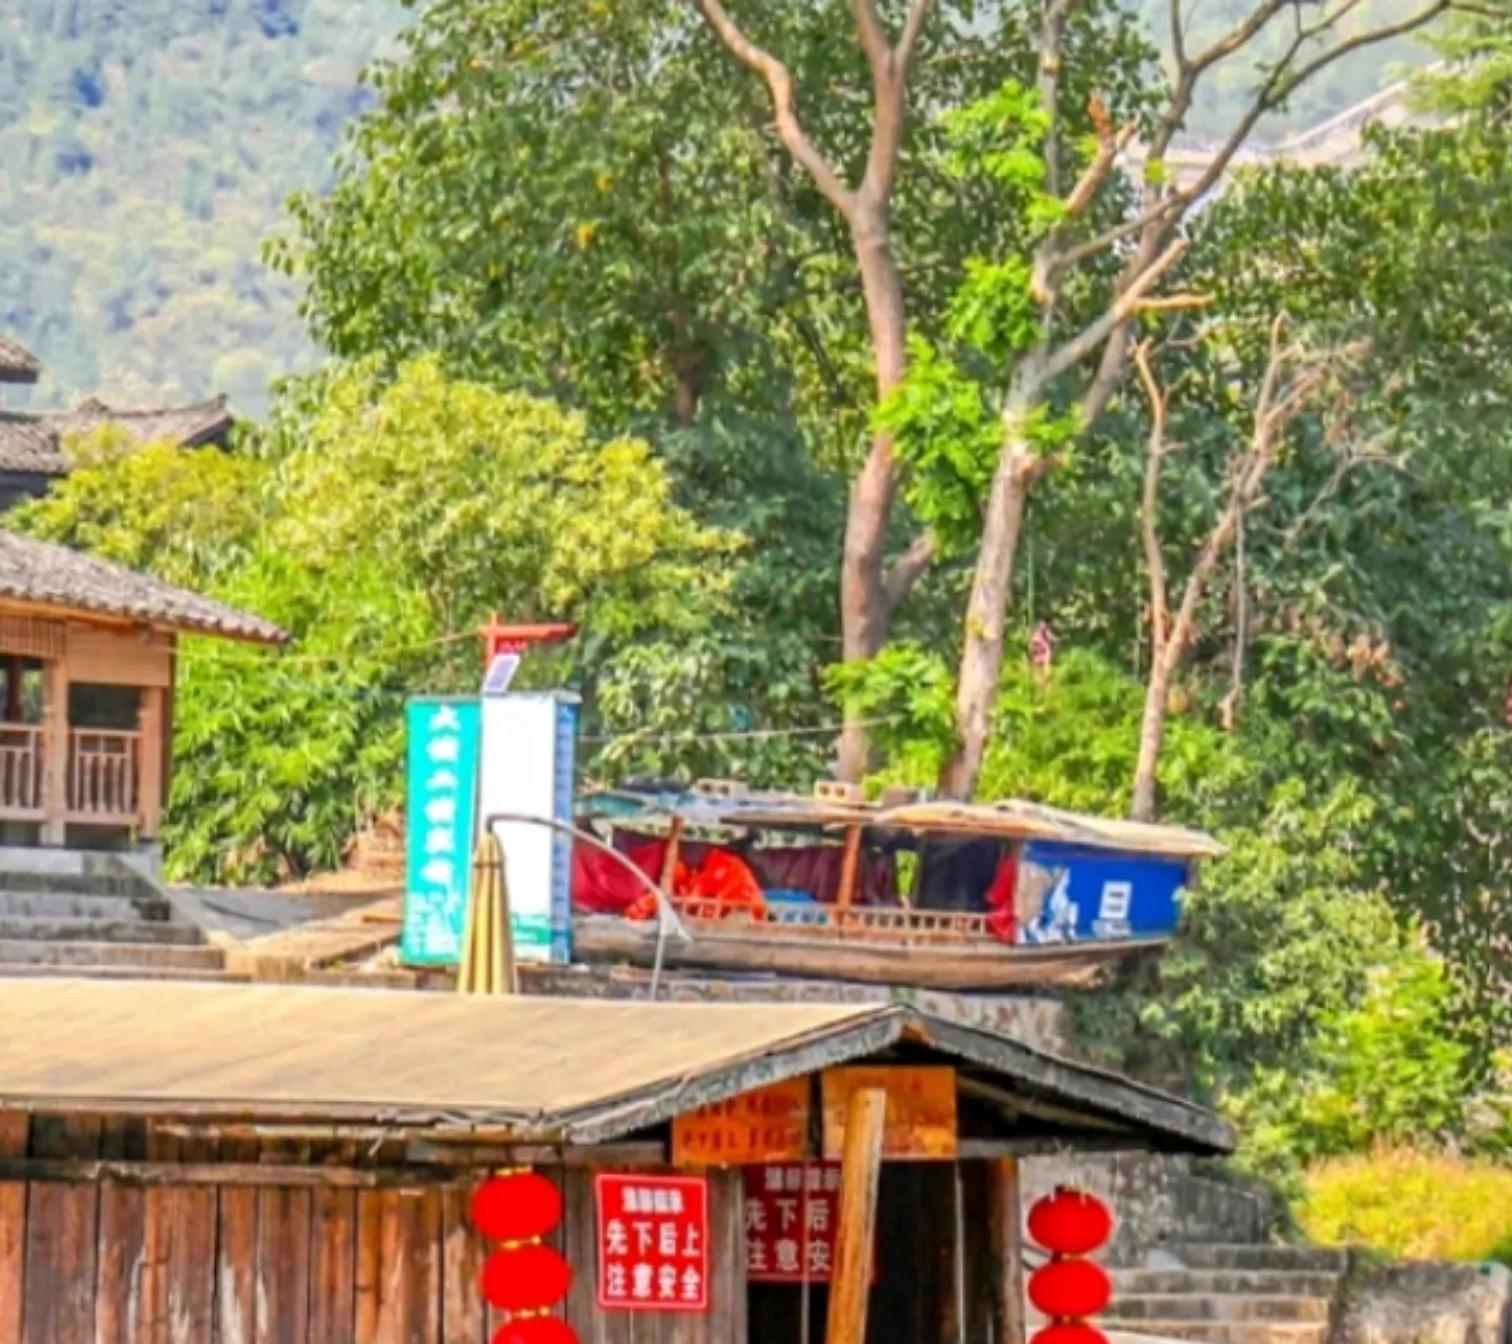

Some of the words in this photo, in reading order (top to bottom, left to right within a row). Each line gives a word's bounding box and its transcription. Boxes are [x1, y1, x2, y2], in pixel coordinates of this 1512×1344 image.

[746, 1199, 831, 1232] 先下后
[606, 1218, 700, 1257] 先下后上
[746, 1238, 832, 1272] 注意安
[606, 1262, 701, 1299] 注意安全
